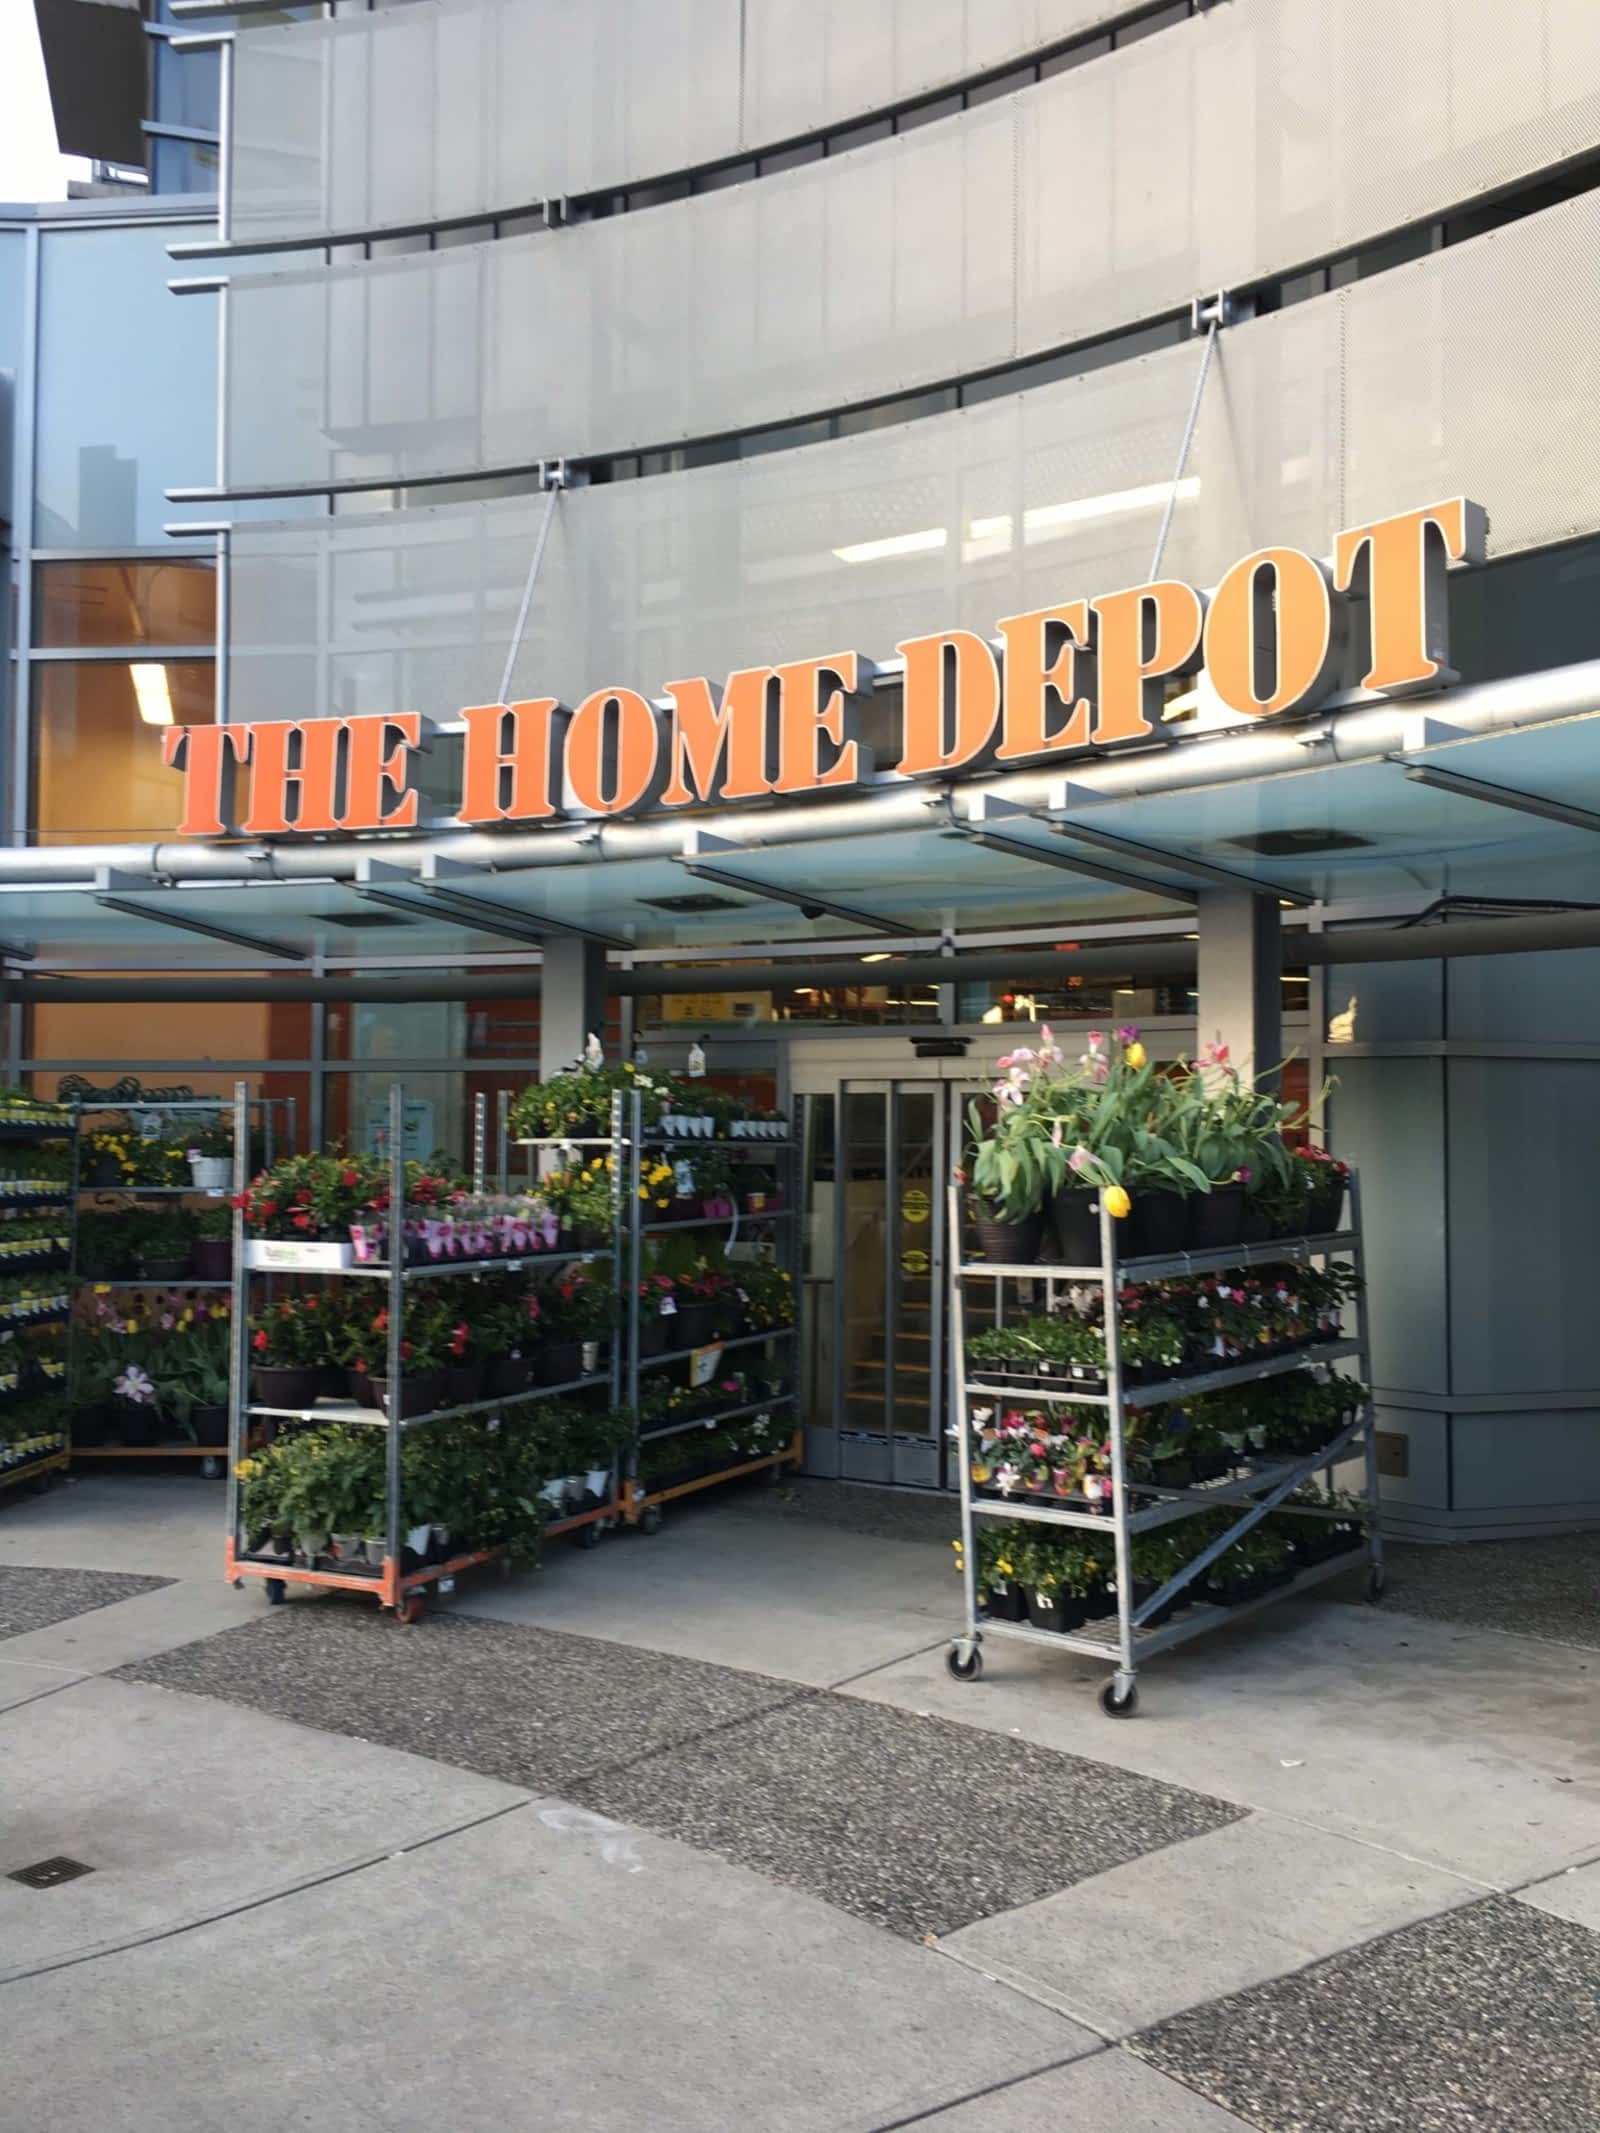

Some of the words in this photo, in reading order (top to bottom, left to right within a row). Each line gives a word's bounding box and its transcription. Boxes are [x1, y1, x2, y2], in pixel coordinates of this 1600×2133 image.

[162, 712, 422, 836] THE
[458, 651, 858, 824] HOME
[897, 496, 1466, 777] DEPOT
